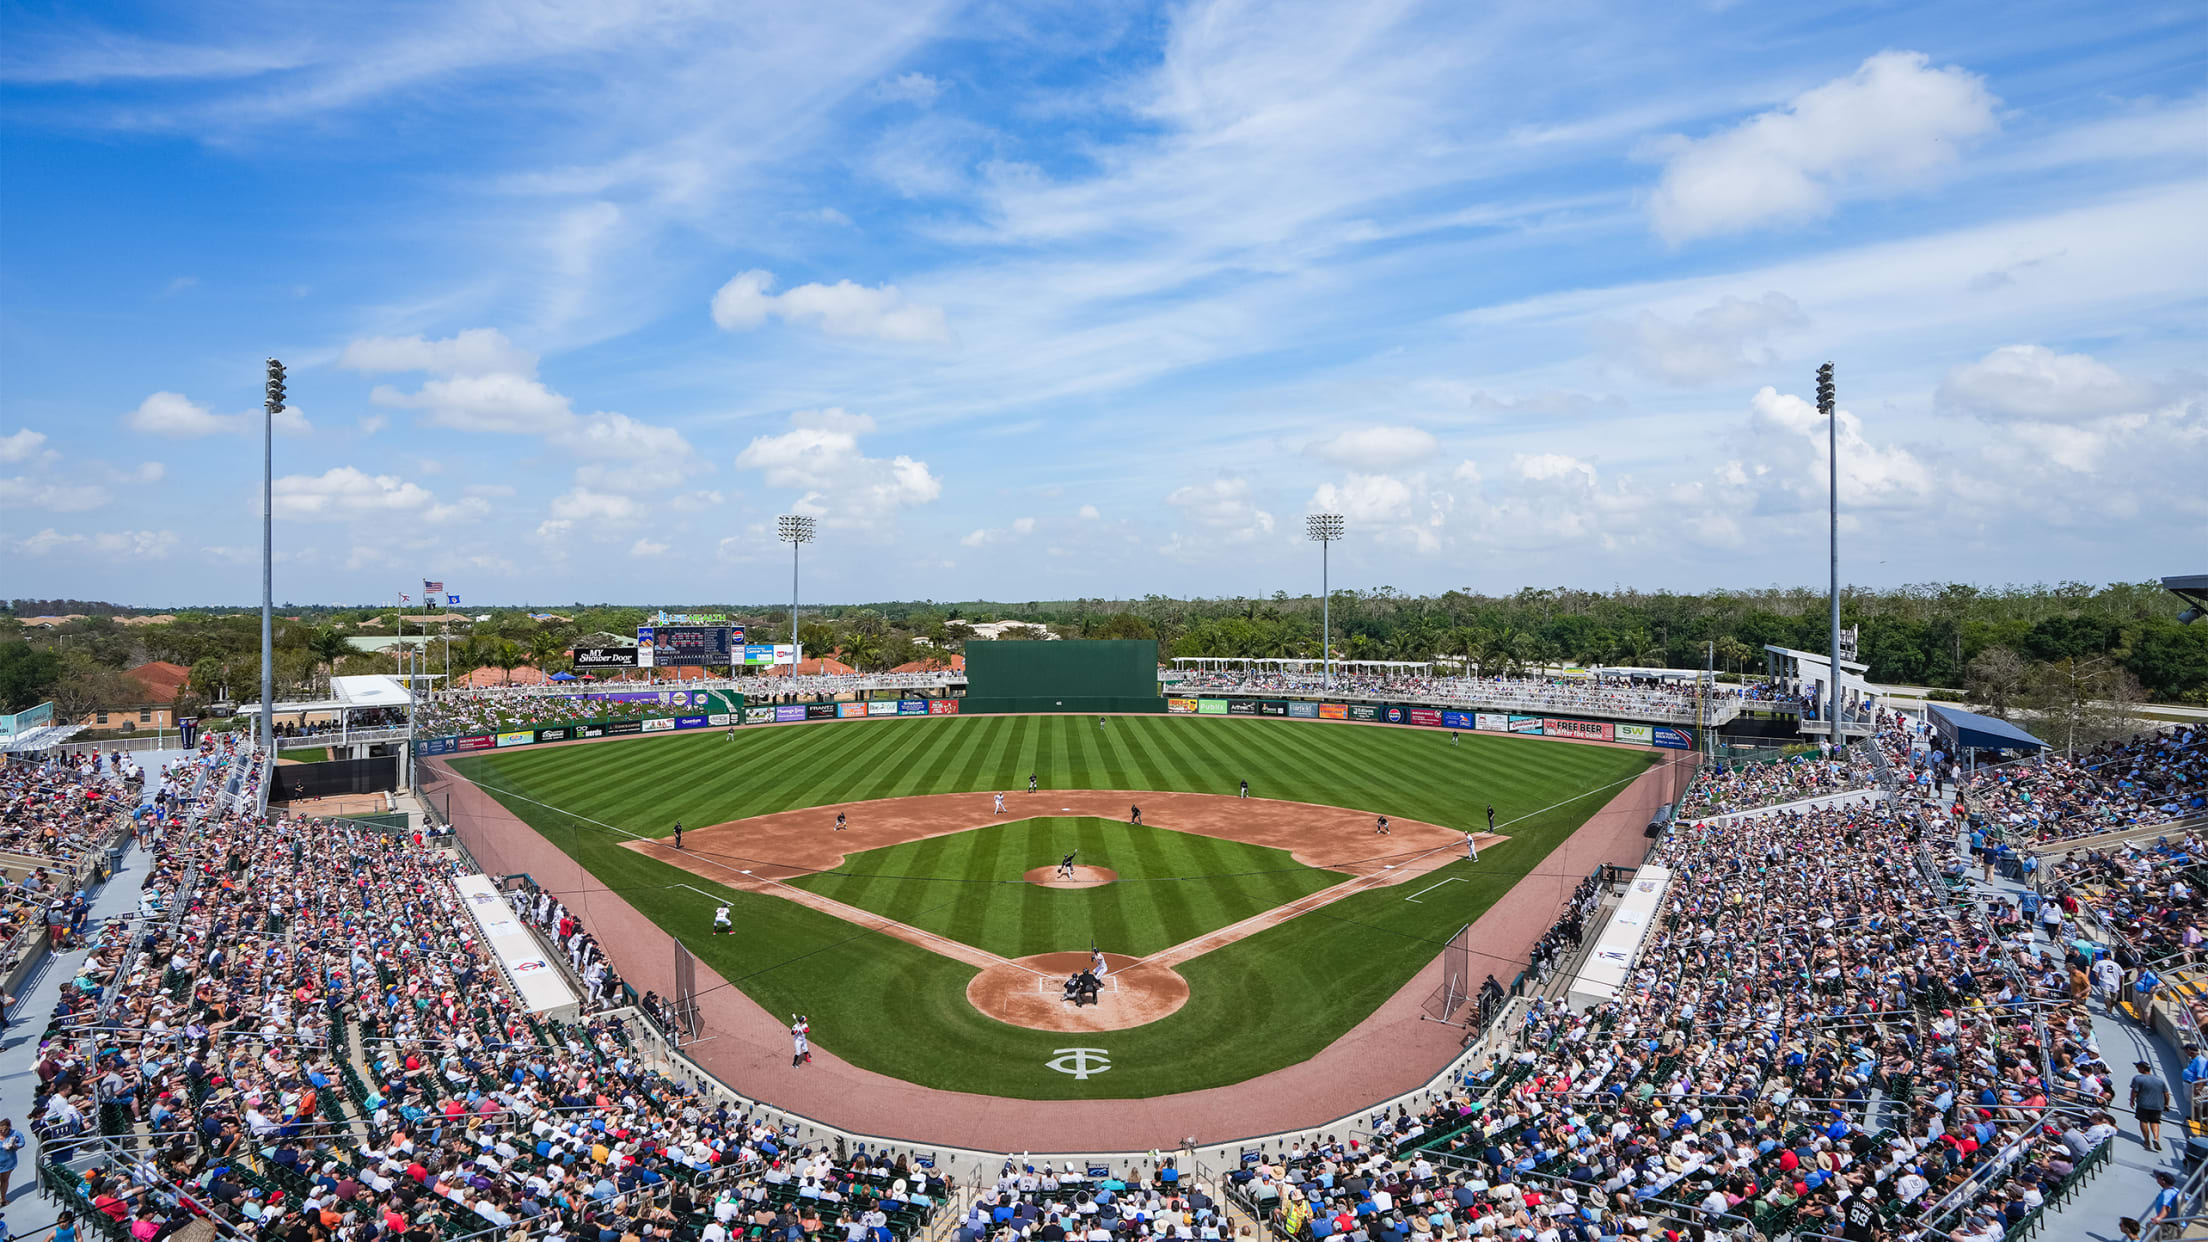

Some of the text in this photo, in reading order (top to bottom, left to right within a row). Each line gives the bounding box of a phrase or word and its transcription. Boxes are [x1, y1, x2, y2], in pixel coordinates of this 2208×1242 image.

[689, 614, 726, 622] HEALTH
[589, 649, 604, 657] MY
[612, 654, 632, 662] Door
[1557, 721, 1602, 734] FREE BEER
[1622, 726, 1645, 736] SW
[2106, 964, 2114, 974] 2
[55, 1126, 69, 1135] 111
[1852, 1201, 1874, 1217] JUDGE
[1849, 1208, 1869, 1228] 99
